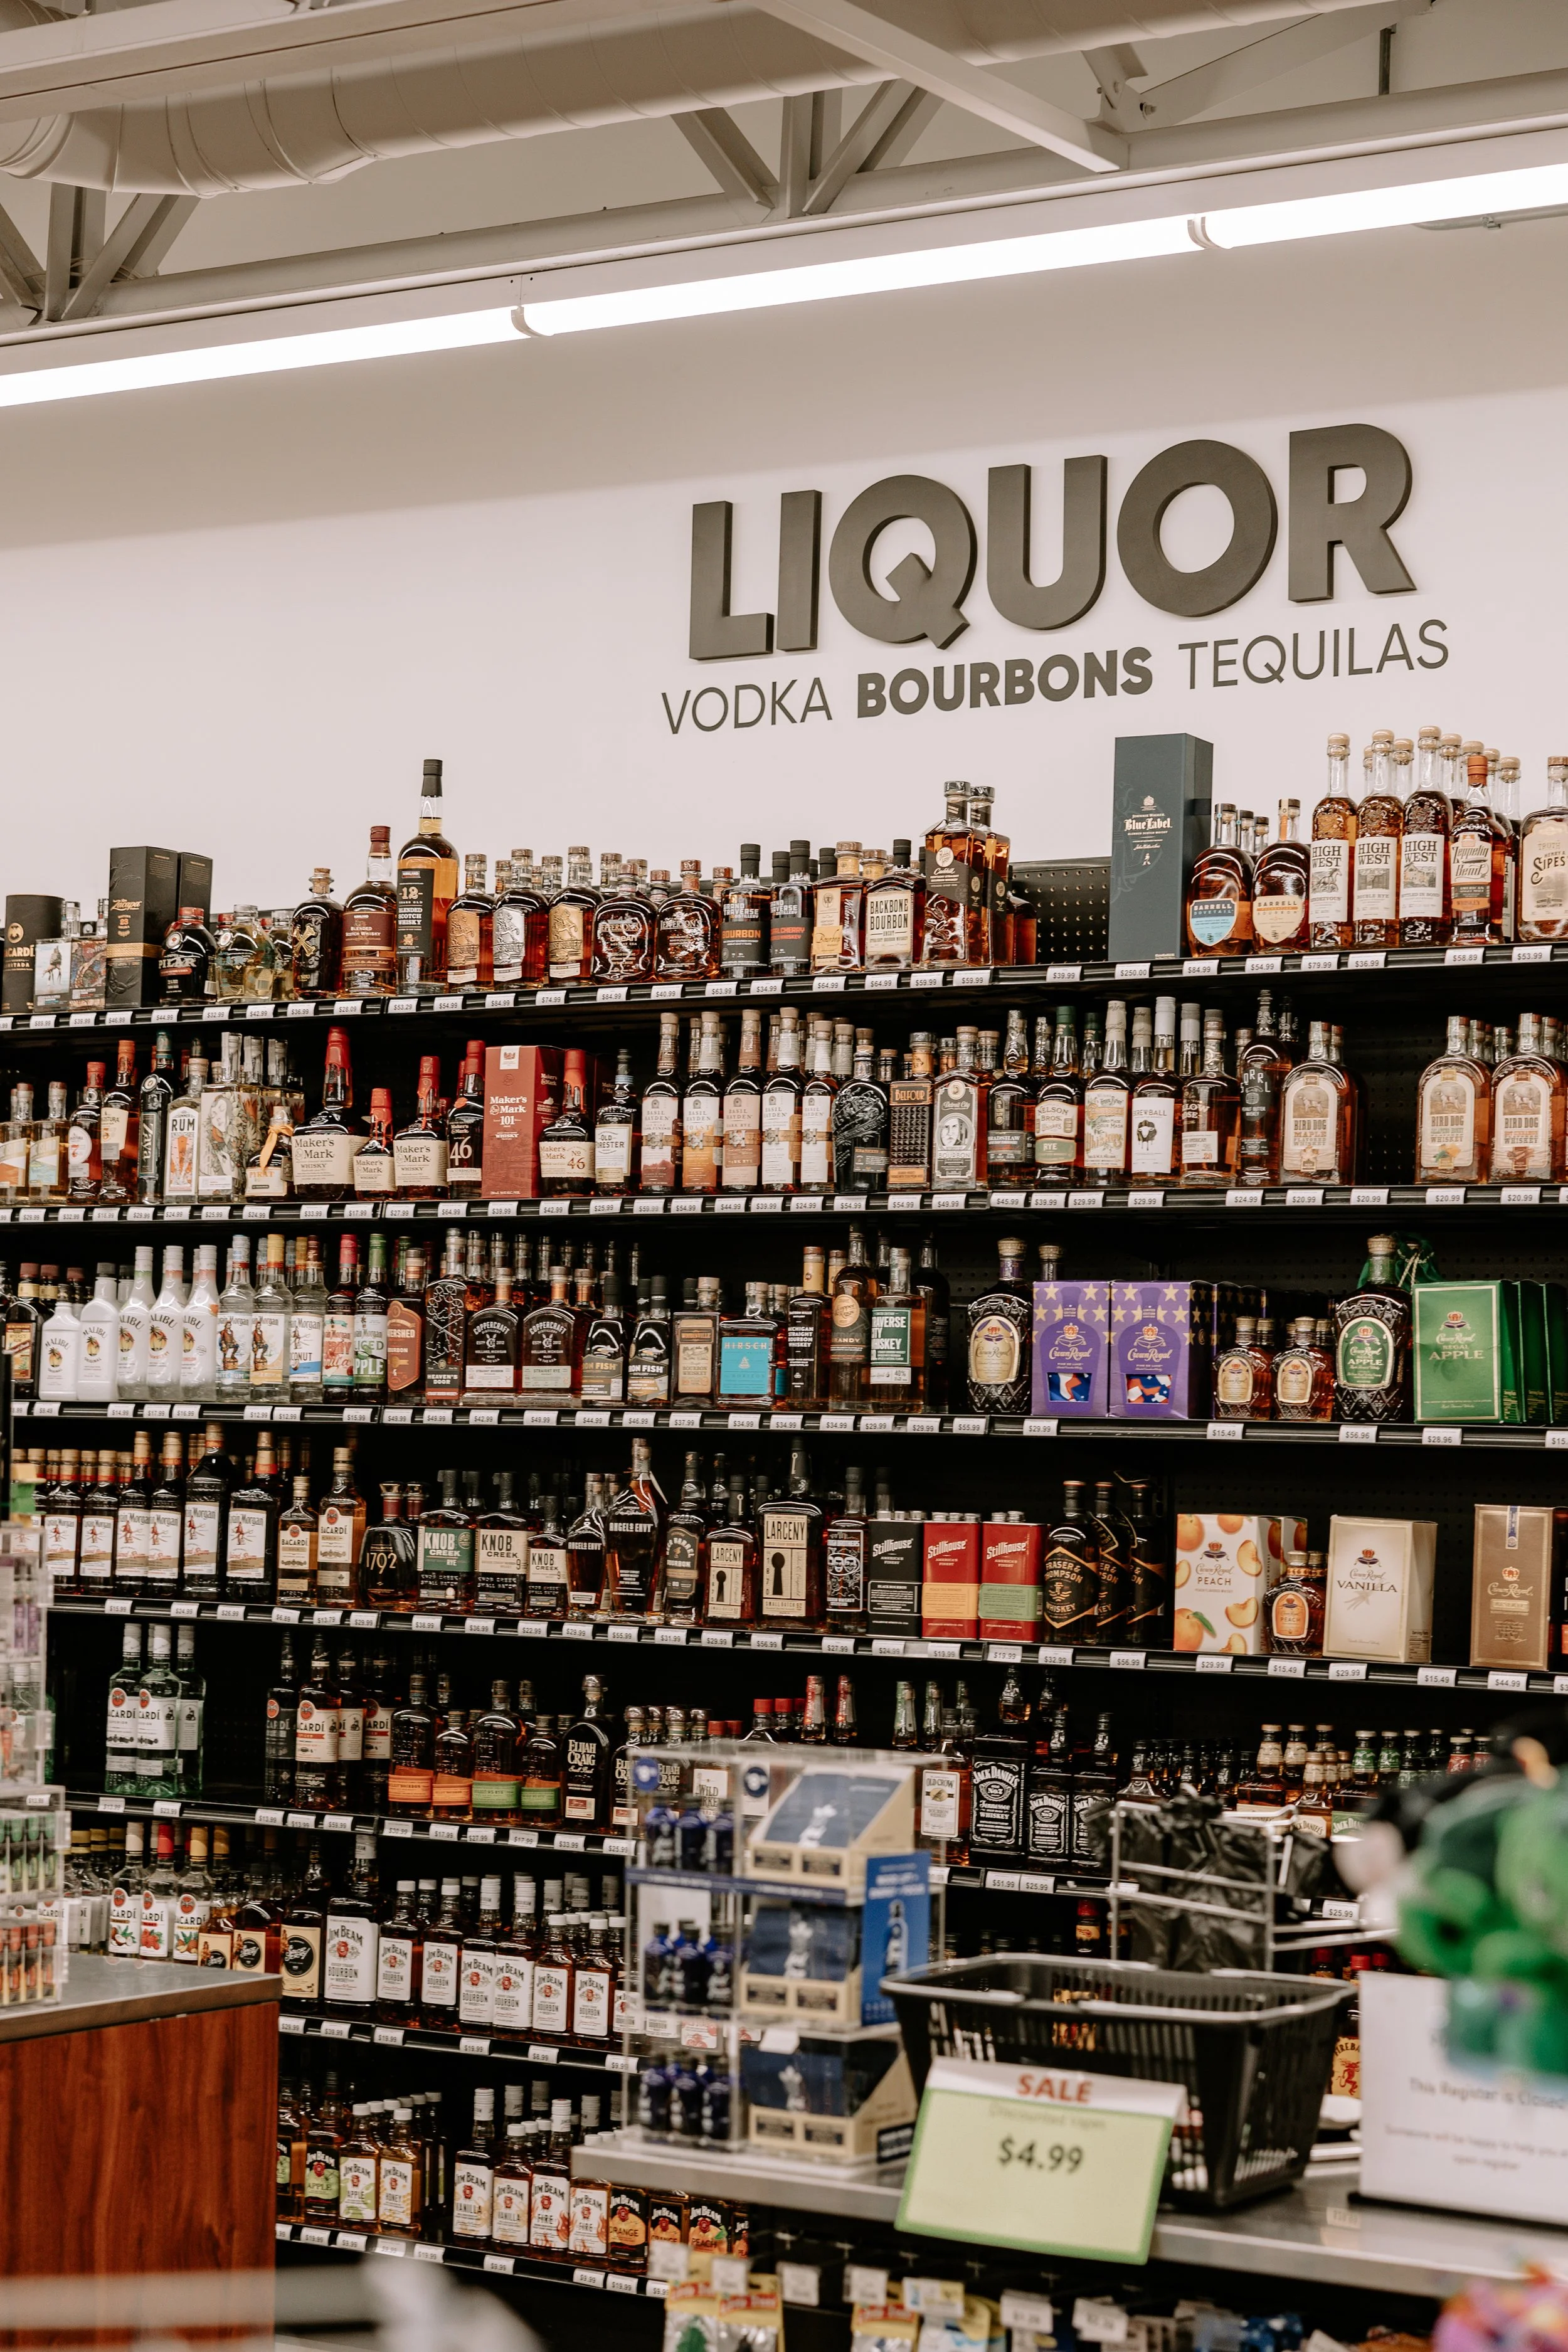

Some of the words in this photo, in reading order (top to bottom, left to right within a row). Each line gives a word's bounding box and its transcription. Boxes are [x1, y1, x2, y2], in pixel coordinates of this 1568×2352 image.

[689, 423, 1418, 660] LIQUOR
[661, 677, 833, 735] VODKA
[857, 646, 1154, 719] BOURBONS
[1178, 618, 1449, 691] TEQUILAS
[1124, 817, 1147, 831] Blue
[1311, 845, 1342, 857] HIGH
[1358, 842, 1391, 854] HIGH
[1405, 840, 1438, 852] HIGH
[1311, 857, 1342, 867] WEST
[1358, 854, 1391, 865] WEST
[1405, 852, 1438, 862] WEST
[870, 898, 909, 914] BACKBONE
[1193, 903, 1232, 911] BARRELL
[870, 914, 909, 930] BOURBON
[489, 1096, 527, 1104] Maker's
[895, 1088, 925, 1101] BELFOUR
[499, 1104, 527, 1114] Mark
[171, 1118, 195, 1131] RUM
[500, 1116, 515, 1125] 101
[1431, 1116, 1448, 1126] BIRD
[1449, 1115, 1464, 1126] DOG
[1504, 1118, 1522, 1129] BIRD
[1523, 1117, 1539, 1128] DOG
[295, 1138, 334, 1147] Maker's
[395, 1145, 431, 1153] Maker's
[1043, 1142, 1058, 1150] RYE
[304, 1150, 333, 1159] Mark
[449, 1136, 472, 1166] 46
[403, 1154, 430, 1162] Mark
[567, 1157, 585, 1170] 46
[724, 1342, 768, 1350] HIRSCH
[1049, 1347, 1072, 1359] Crown
[1127, 1348, 1151, 1360] Crown
[1428, 1350, 1486, 1360] APPLE
[1347, 1358, 1384, 1366] APPLE
[766, 1520, 805, 1541] LARCENY
[425, 1532, 456, 1550] KNOB
[481, 1534, 512, 1551] KNOB
[872, 1538, 913, 1557] Stillhouse
[711, 1547, 742, 1563] LARCENY
[928, 1540, 967, 1559] Stillhouse
[986, 1540, 1027, 1560] Stillhouse
[366, 1552, 398, 1574] 1792
[531, 1552, 554, 1565] KNOB
[1197, 1576, 1232, 1586] PEACH
[1337, 1580, 1399, 1593] VANILLA
[1487, 1582, 1510, 1596] Crown
[568, 1739, 596, 1754] ELIJAH
[567, 1752, 596, 1766] CRAIG
[973, 1767, 992, 1785] JACK
[979, 1811, 1009, 1820] WHISKEY
[1328, 1909, 1353, 1919] $25.99
[1016, 2072, 1093, 2104] SALE
[1439, 2080, 1498, 2102] Register
[998, 2136, 1084, 2175] $4.99
